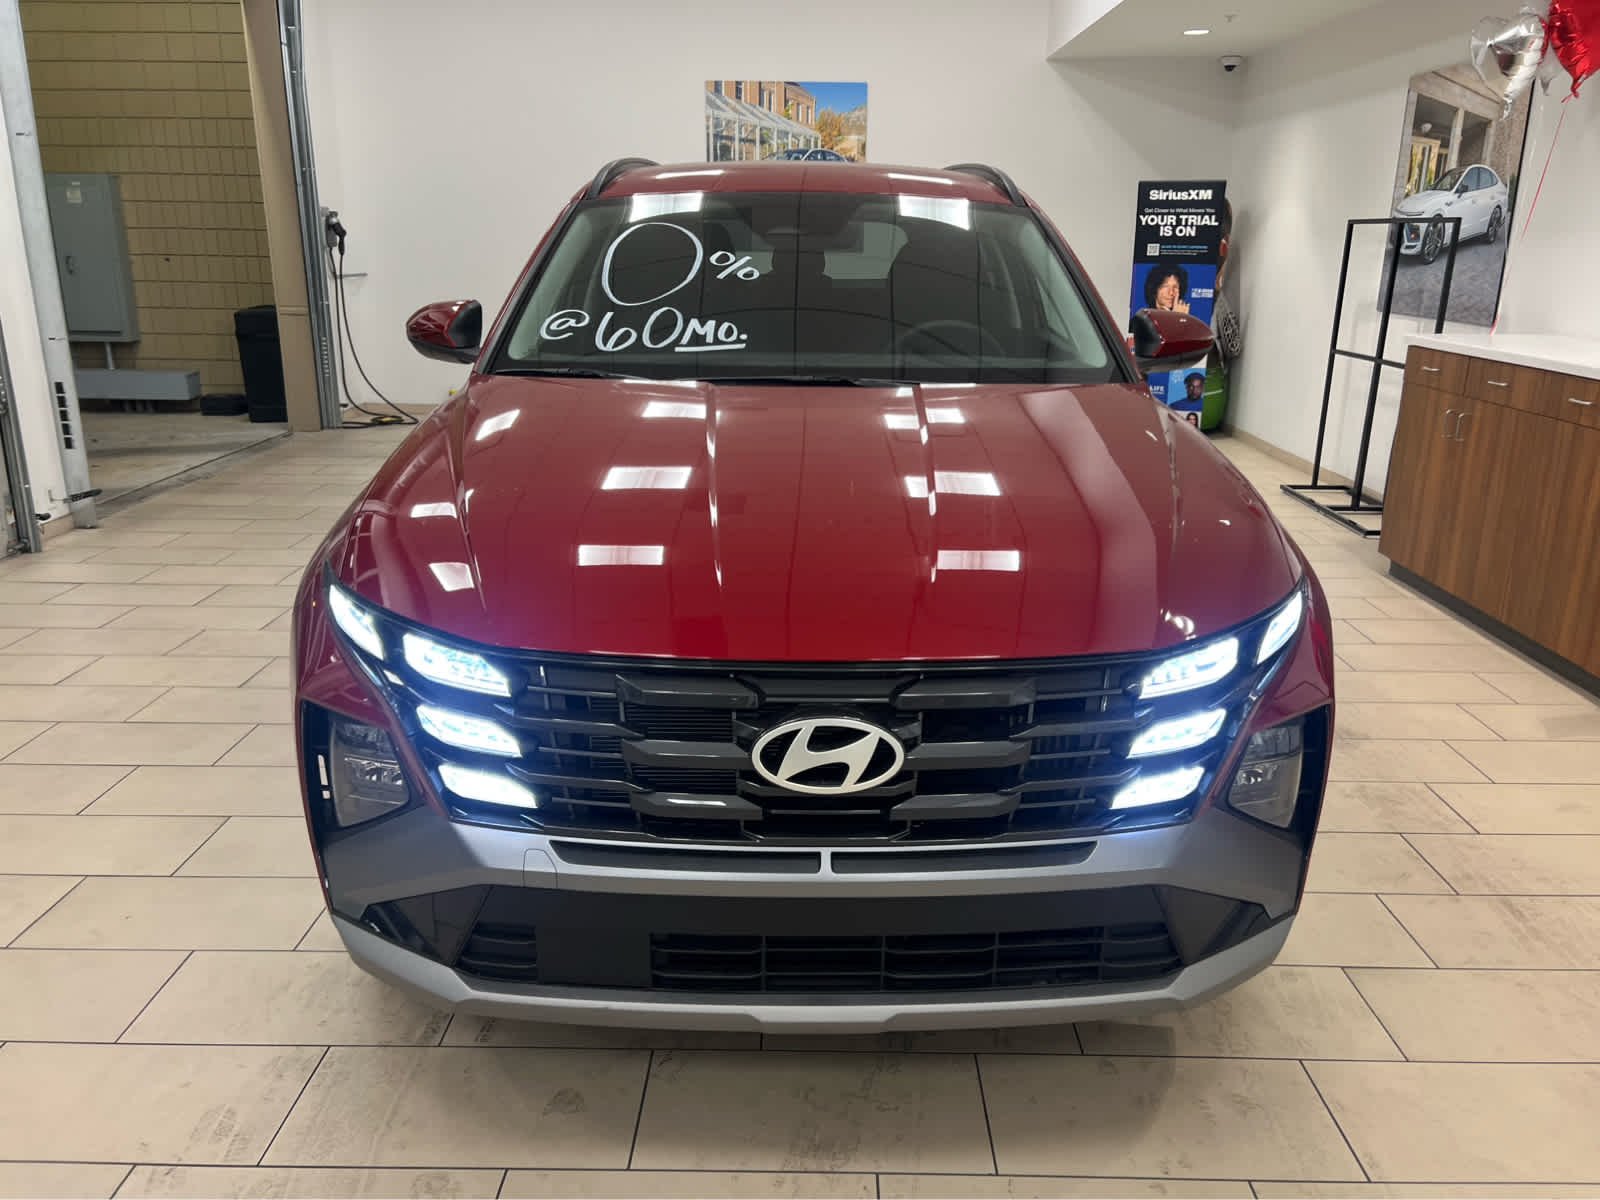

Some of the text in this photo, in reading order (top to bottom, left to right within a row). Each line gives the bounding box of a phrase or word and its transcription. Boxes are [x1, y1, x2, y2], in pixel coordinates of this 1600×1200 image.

[1149, 189, 1213, 200] SiriusXM
[1139, 215, 1219, 226] YOUR TRIAL
[1160, 226, 1196, 237] IS ON
